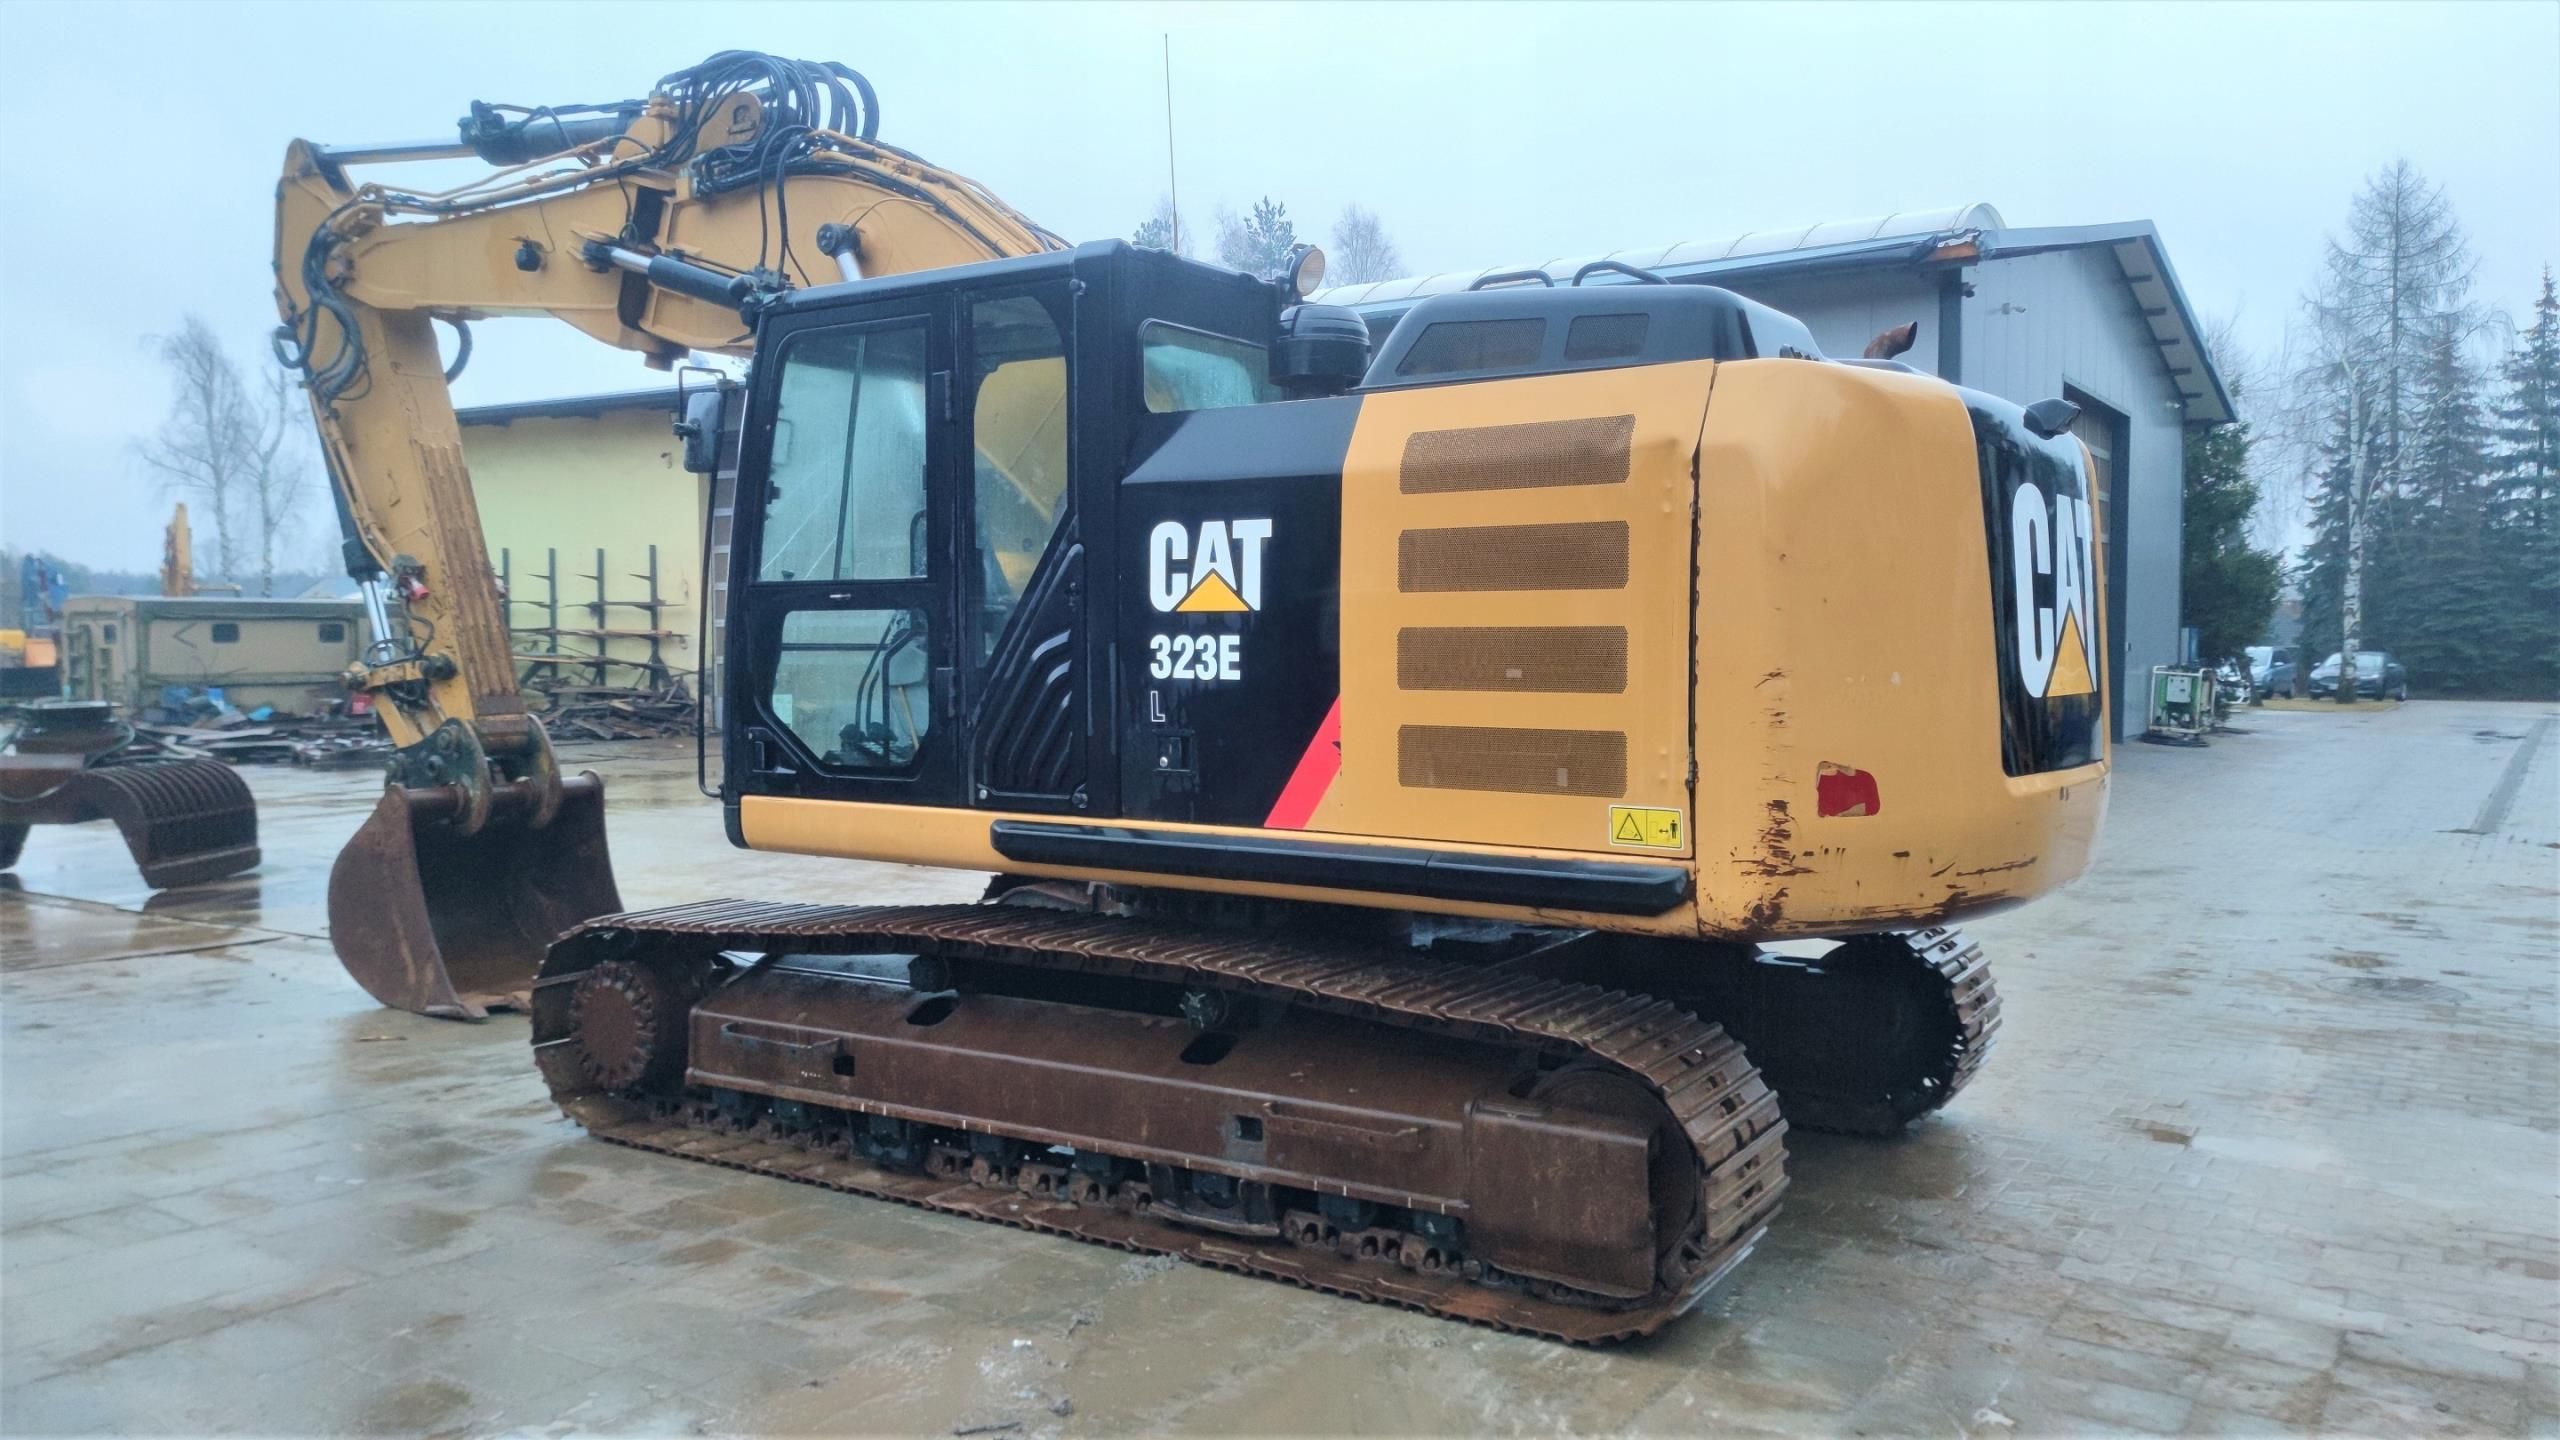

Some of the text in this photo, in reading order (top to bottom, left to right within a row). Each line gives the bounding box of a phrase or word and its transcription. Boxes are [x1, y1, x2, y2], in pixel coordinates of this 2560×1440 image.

[1149, 518, 1273, 613] CAT
[2012, 482, 2098, 698] CAT
[1150, 633, 1241, 681] 323E
[1150, 690, 1166, 723] L
